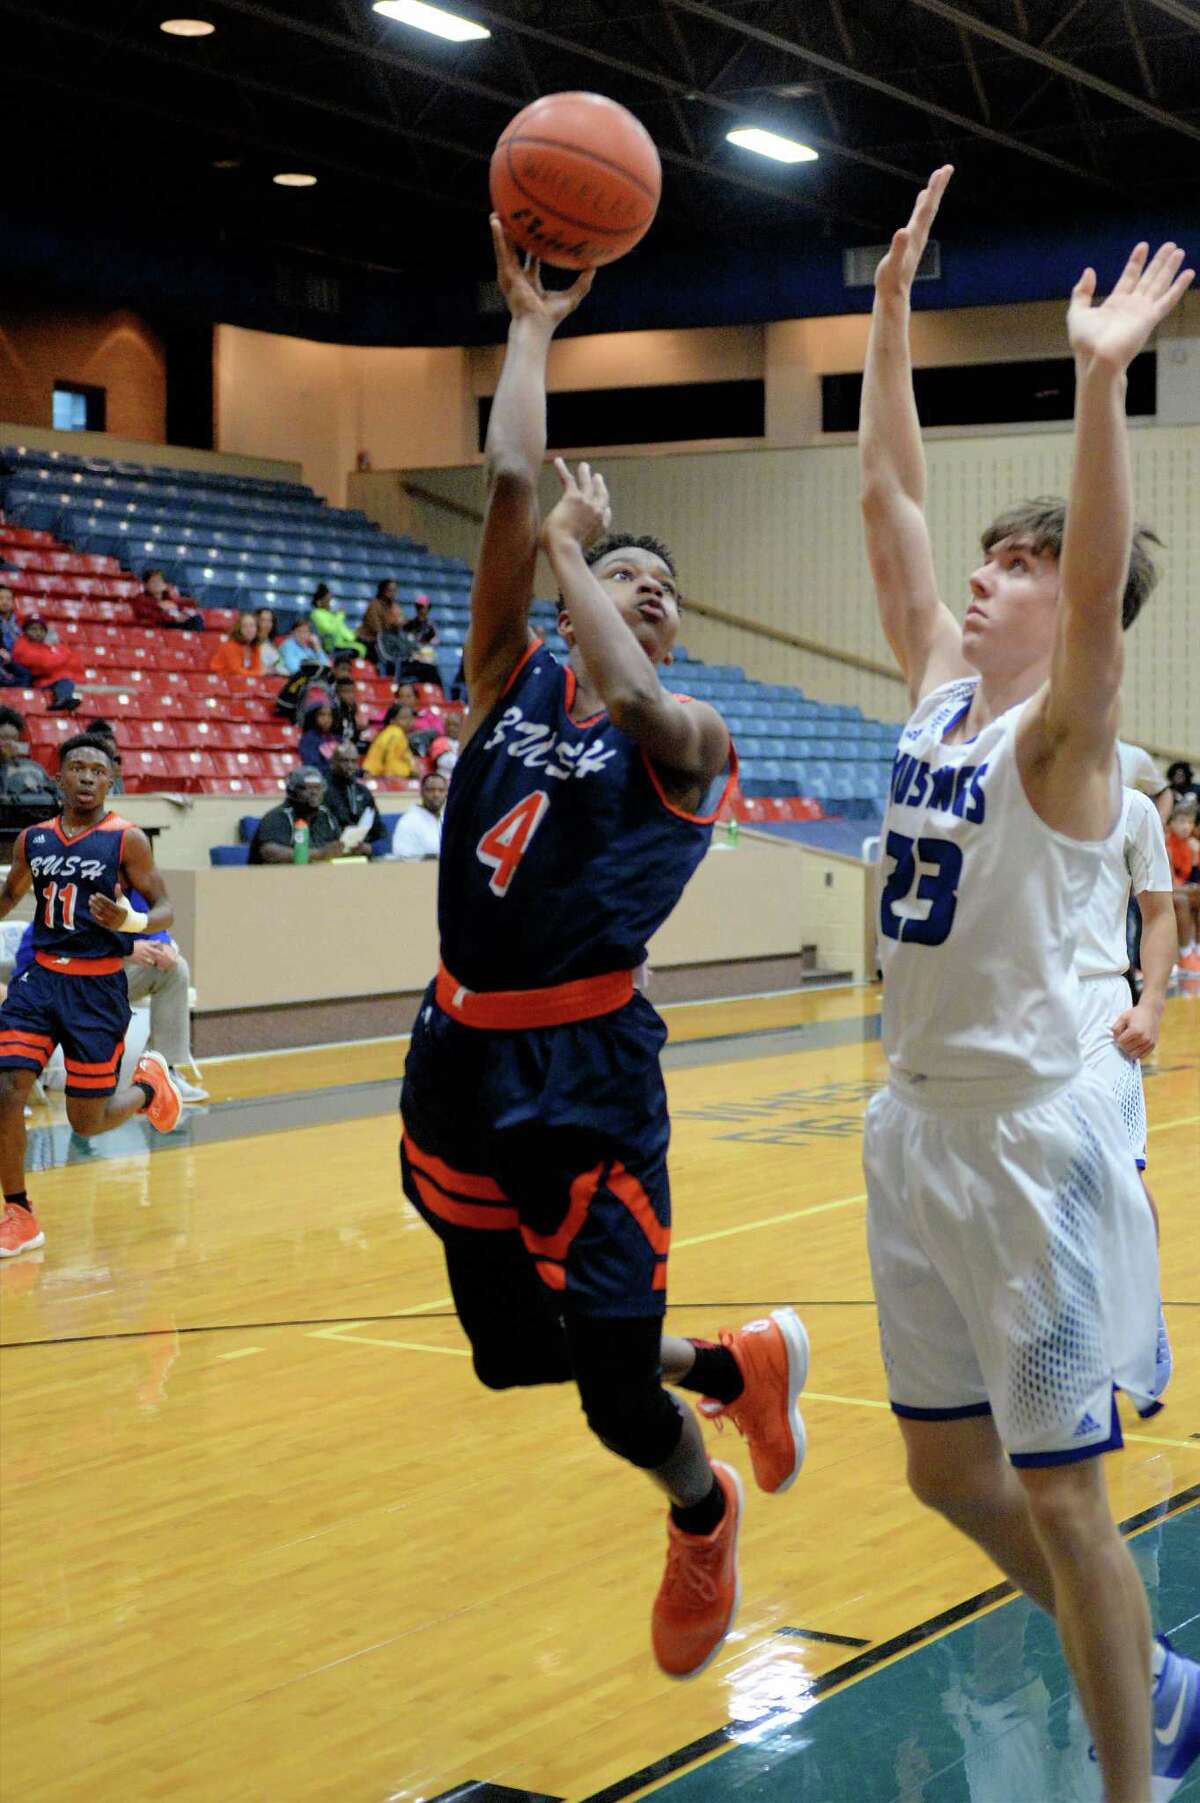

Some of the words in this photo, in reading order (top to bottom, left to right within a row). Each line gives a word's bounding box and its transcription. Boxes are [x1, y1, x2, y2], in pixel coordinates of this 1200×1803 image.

[30, 855, 106, 880] BUSH
[476, 790, 549, 898] 4
[43, 881, 77, 930] 11
[880, 830, 963, 947] 23
